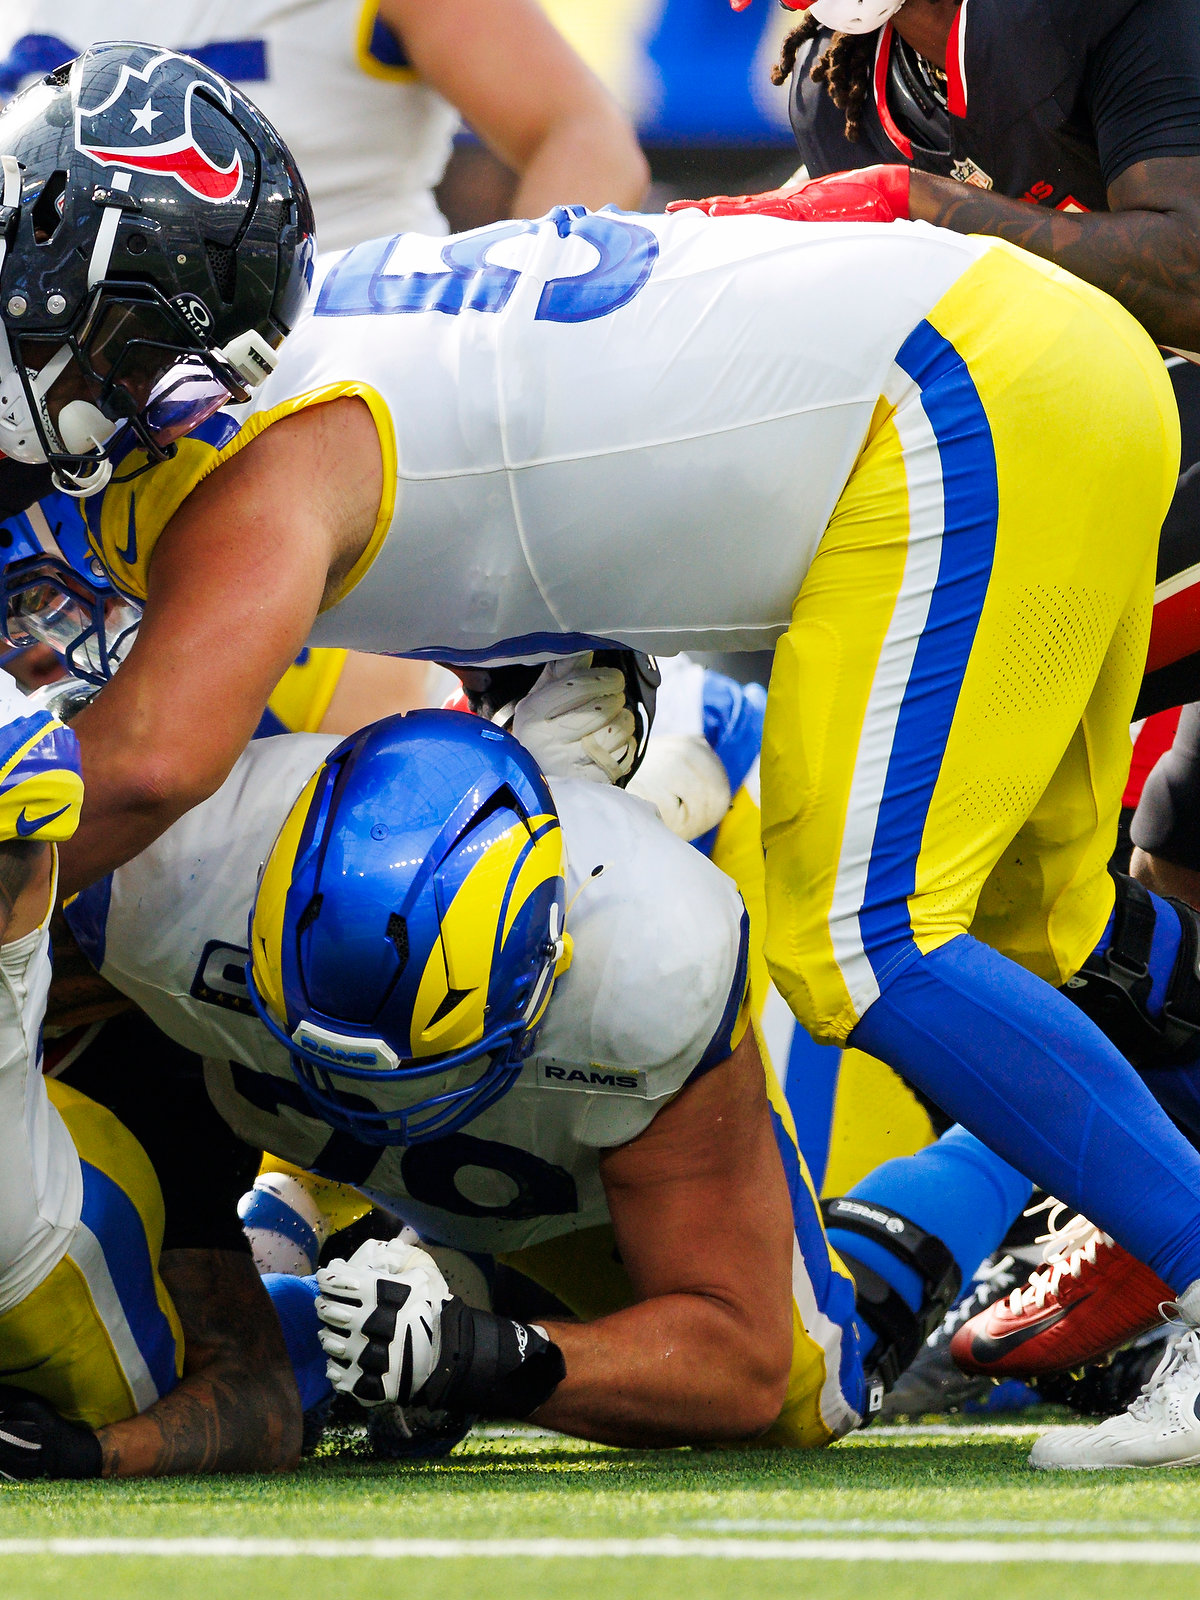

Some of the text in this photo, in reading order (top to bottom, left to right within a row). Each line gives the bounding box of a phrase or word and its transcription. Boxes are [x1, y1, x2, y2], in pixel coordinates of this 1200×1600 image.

[176, 298, 205, 338] OAKLEY
[300, 1034, 378, 1066] RAMS
[544, 1065, 639, 1089] RAMS
